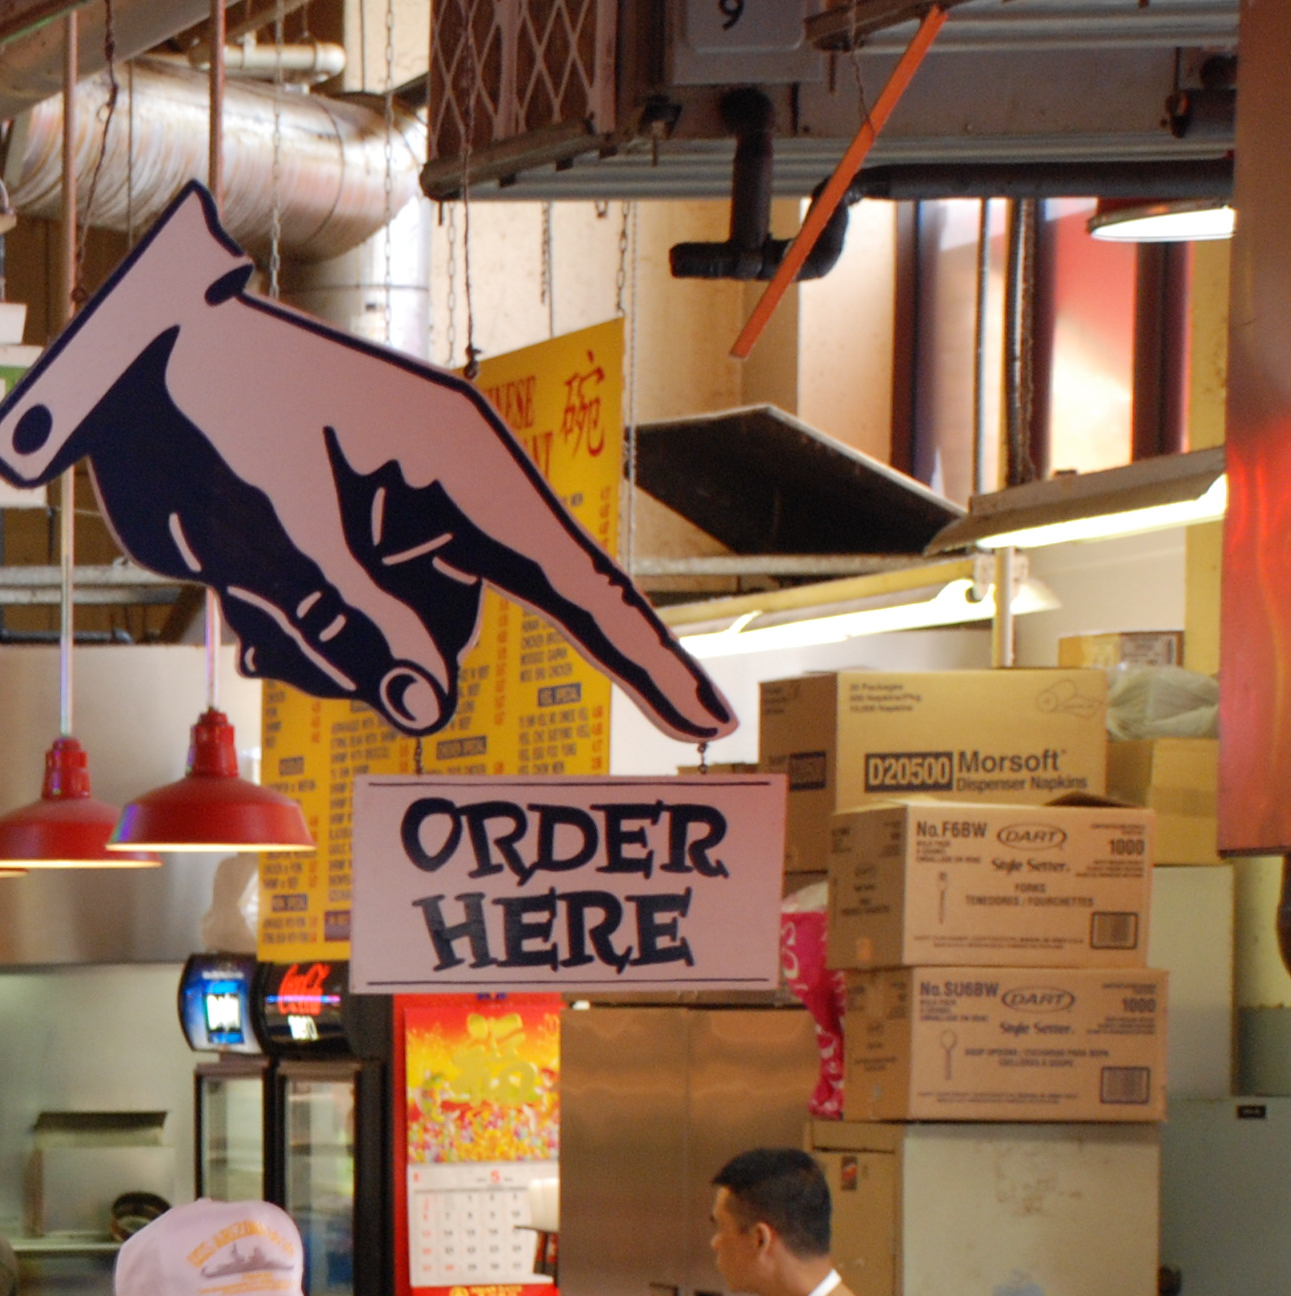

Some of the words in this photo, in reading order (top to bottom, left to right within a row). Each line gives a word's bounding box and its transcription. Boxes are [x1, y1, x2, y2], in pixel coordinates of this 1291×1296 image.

[870, 756, 951, 787] D20500
[959, 750, 1060, 774] Morsoft
[957, 776, 1025, 793] Dispenser
[1031, 774, 1088, 791] Napkins
[401, 797, 729, 886] ORDER
[1005, 830, 1059, 844] DART
[1109, 838, 1145, 855] 1000
[412, 886, 694, 975] HERE
[1011, 993, 1067, 1006] DART
[1123, 997, 1157, 1013] 1000
